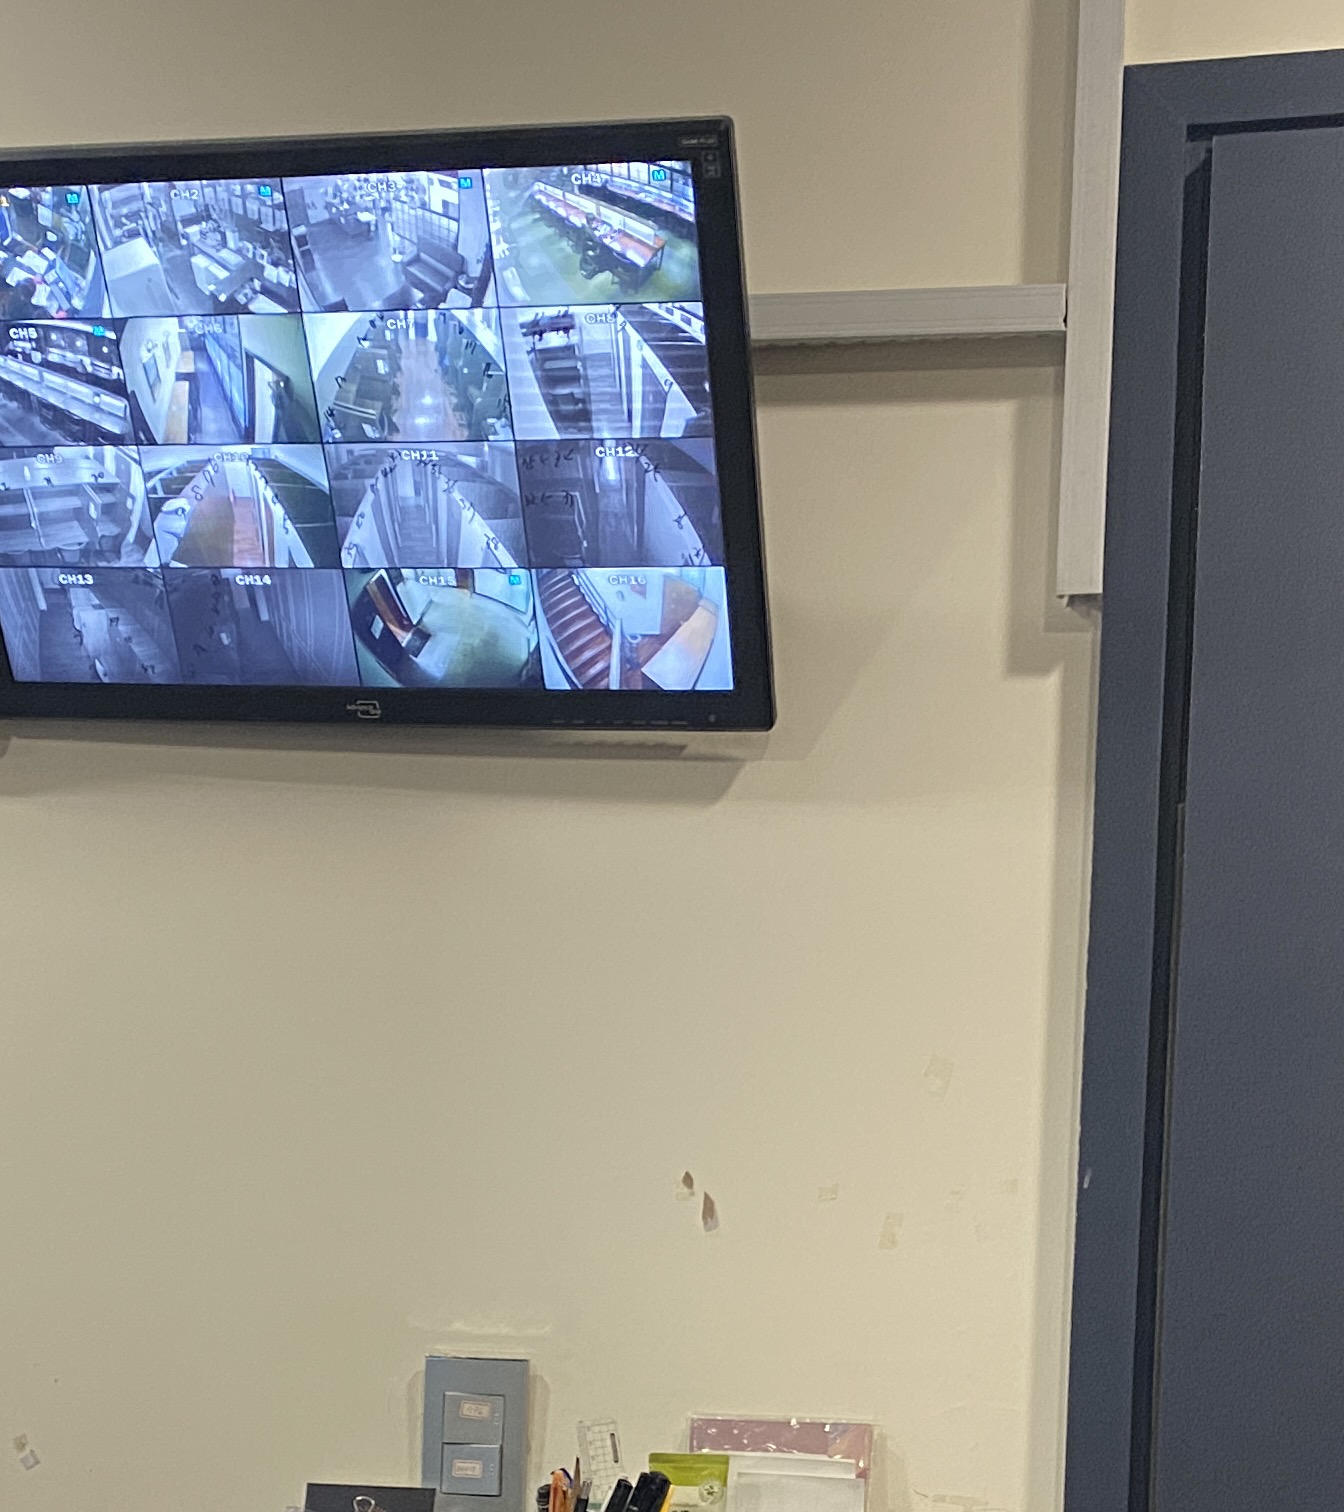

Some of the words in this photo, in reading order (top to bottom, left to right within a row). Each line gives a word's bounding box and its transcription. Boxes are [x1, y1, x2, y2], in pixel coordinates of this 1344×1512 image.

[570, 172, 603, 186] CH4
[170, 189, 199, 200] CH2
[59, 574, 94, 585] CH13
[235, 575, 271, 586] CH14
